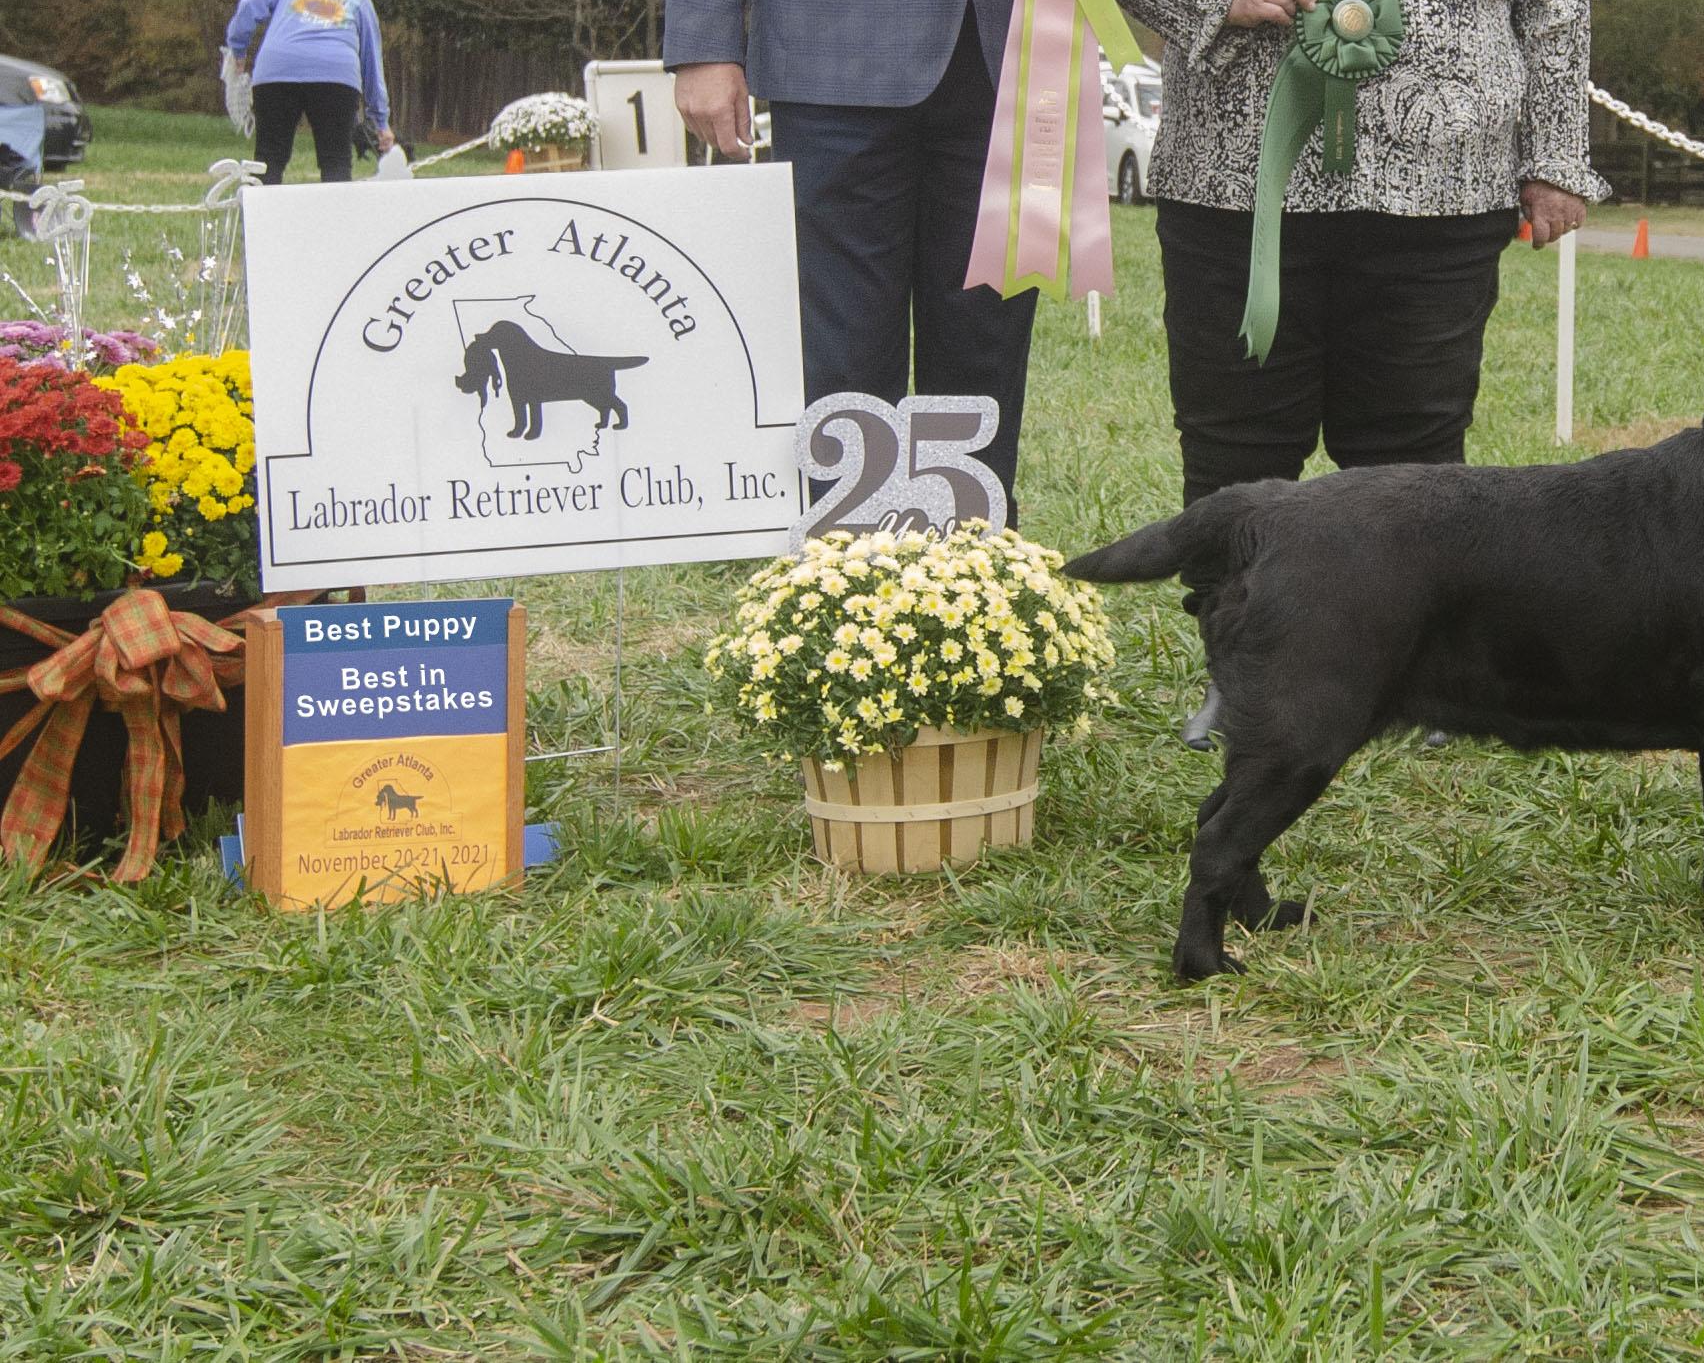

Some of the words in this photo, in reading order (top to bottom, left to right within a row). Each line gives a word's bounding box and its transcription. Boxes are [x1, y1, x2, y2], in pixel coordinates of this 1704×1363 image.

[627, 91, 647, 155] 1
[363, 229, 514, 353] Greater
[547, 219, 696, 341] Atlanta
[806, 409, 990, 537] 25
[287, 483, 431, 531] Labrador
[447, 474, 603, 519] Retriever
[620, 465, 704, 512] Club,
[724, 462, 786, 501] Inc.
[304, 617, 372, 643] Best
[383, 615, 477, 641] Puppy
[341, 665, 408, 690] Best
[420, 663, 446, 686] in
[297, 687, 493, 719] Sweepstakes
[353, 756, 394, 789] Greater
[396, 754, 434, 782] Atlanta
[333, 826, 374, 841] Labrador
[375, 825, 414, 838] Retriever
[416, 823, 438, 837] Club,
[440, 822, 456, 835] Inc.
[298, 850, 388, 875] November
[451, 844, 489, 865] 2021
